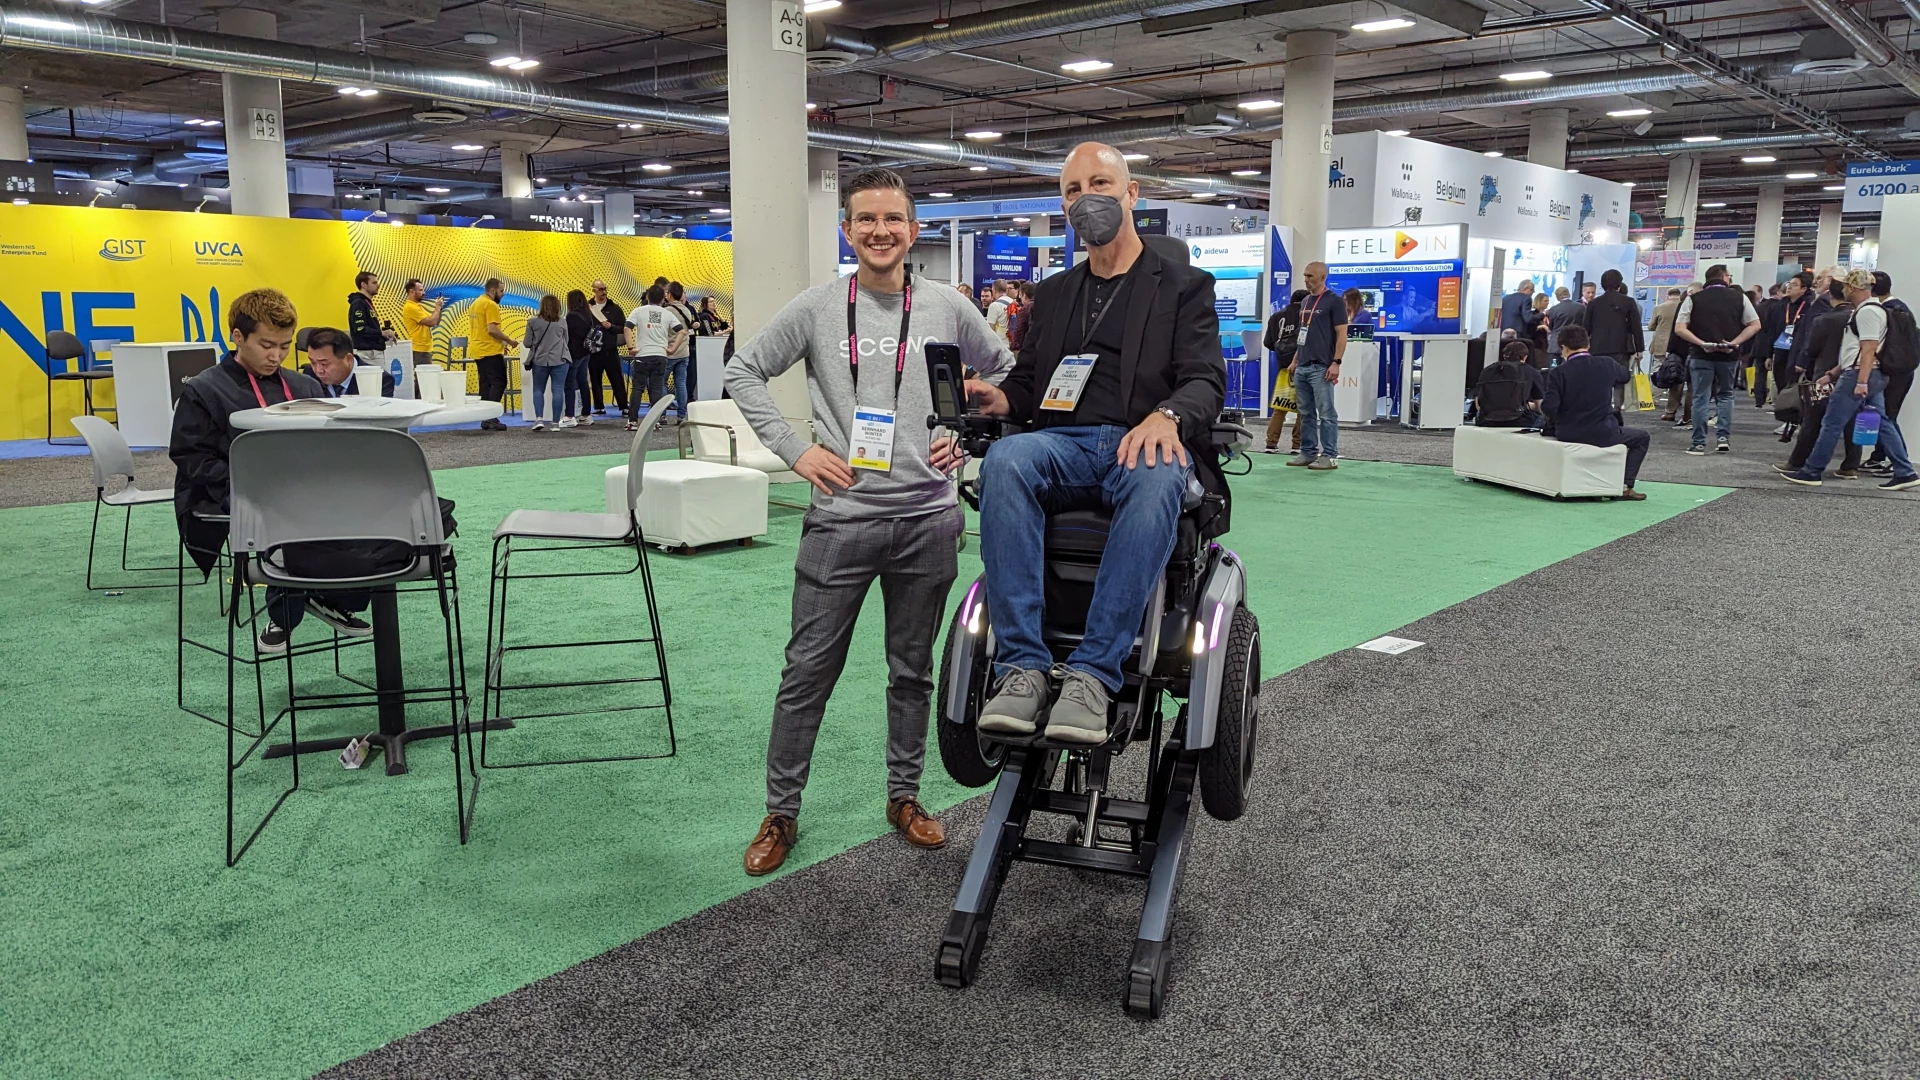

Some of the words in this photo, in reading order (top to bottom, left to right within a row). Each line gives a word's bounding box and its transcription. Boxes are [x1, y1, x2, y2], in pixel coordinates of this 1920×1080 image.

[779, 8, 803, 27] A-G
[781, 29, 793, 45] G
[796, 32, 803, 47] 2
[255, 112, 275, 124] A-G
[256, 126, 265, 136] H
[273, 126, 280, 137] 2
[1850, 165, 1883, 175] Eureka
[1391, 187, 1421, 201] Wallonia.be
[1436, 179, 1466, 200] Belgium
[1858, 182, 1907, 197] 61200
[1549, 199, 1571, 216] Belgium
[104, 239, 147, 255] GIST
[194, 241, 244, 257] UVCA
[1337, 237, 1388, 255] FEEL
[1425, 234, 1448, 252] IN
[1713, 241, 1732, 250] aisle
[1374, 264, 1424, 272] NEUROMARKETING
[1342, 376, 1358, 388] IN
[1272, 396, 1298, 411] Niko
